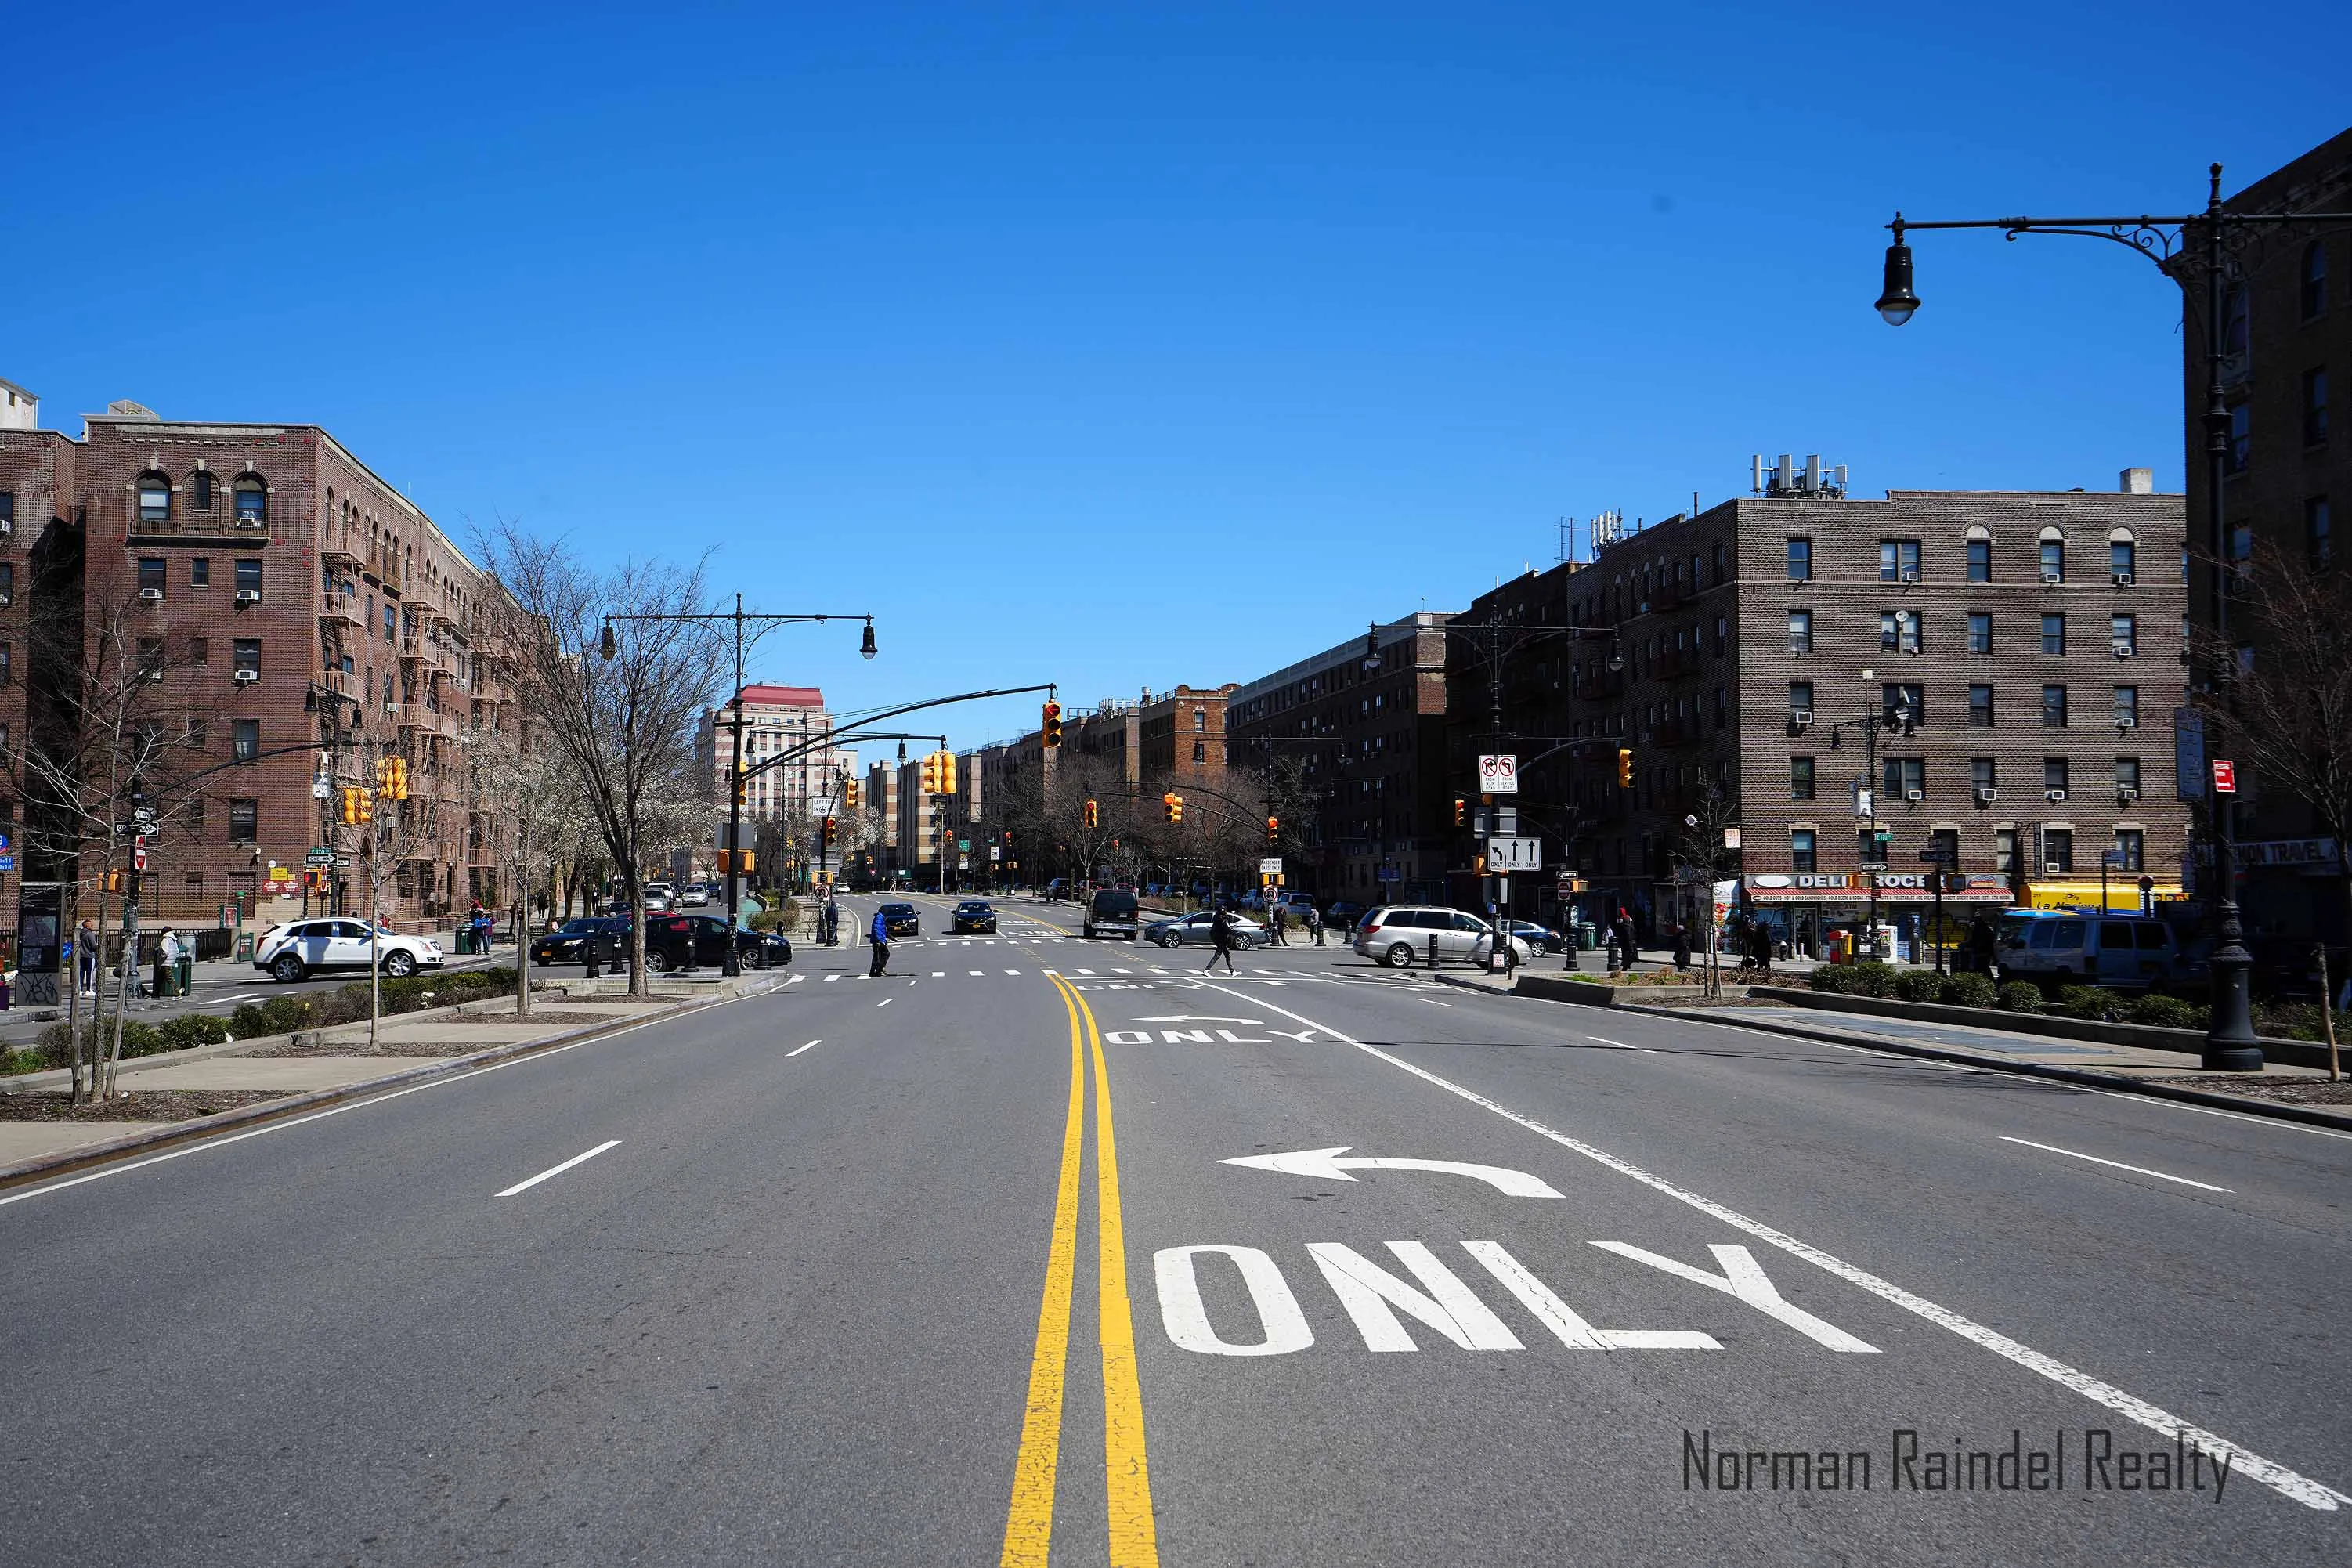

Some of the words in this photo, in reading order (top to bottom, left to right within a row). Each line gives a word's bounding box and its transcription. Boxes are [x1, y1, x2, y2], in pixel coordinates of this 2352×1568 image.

[1798, 875, 1847, 887] DELI
[1104, 1029, 1317, 1044] ONLY
[1153, 1240, 1883, 1357] ONLY
